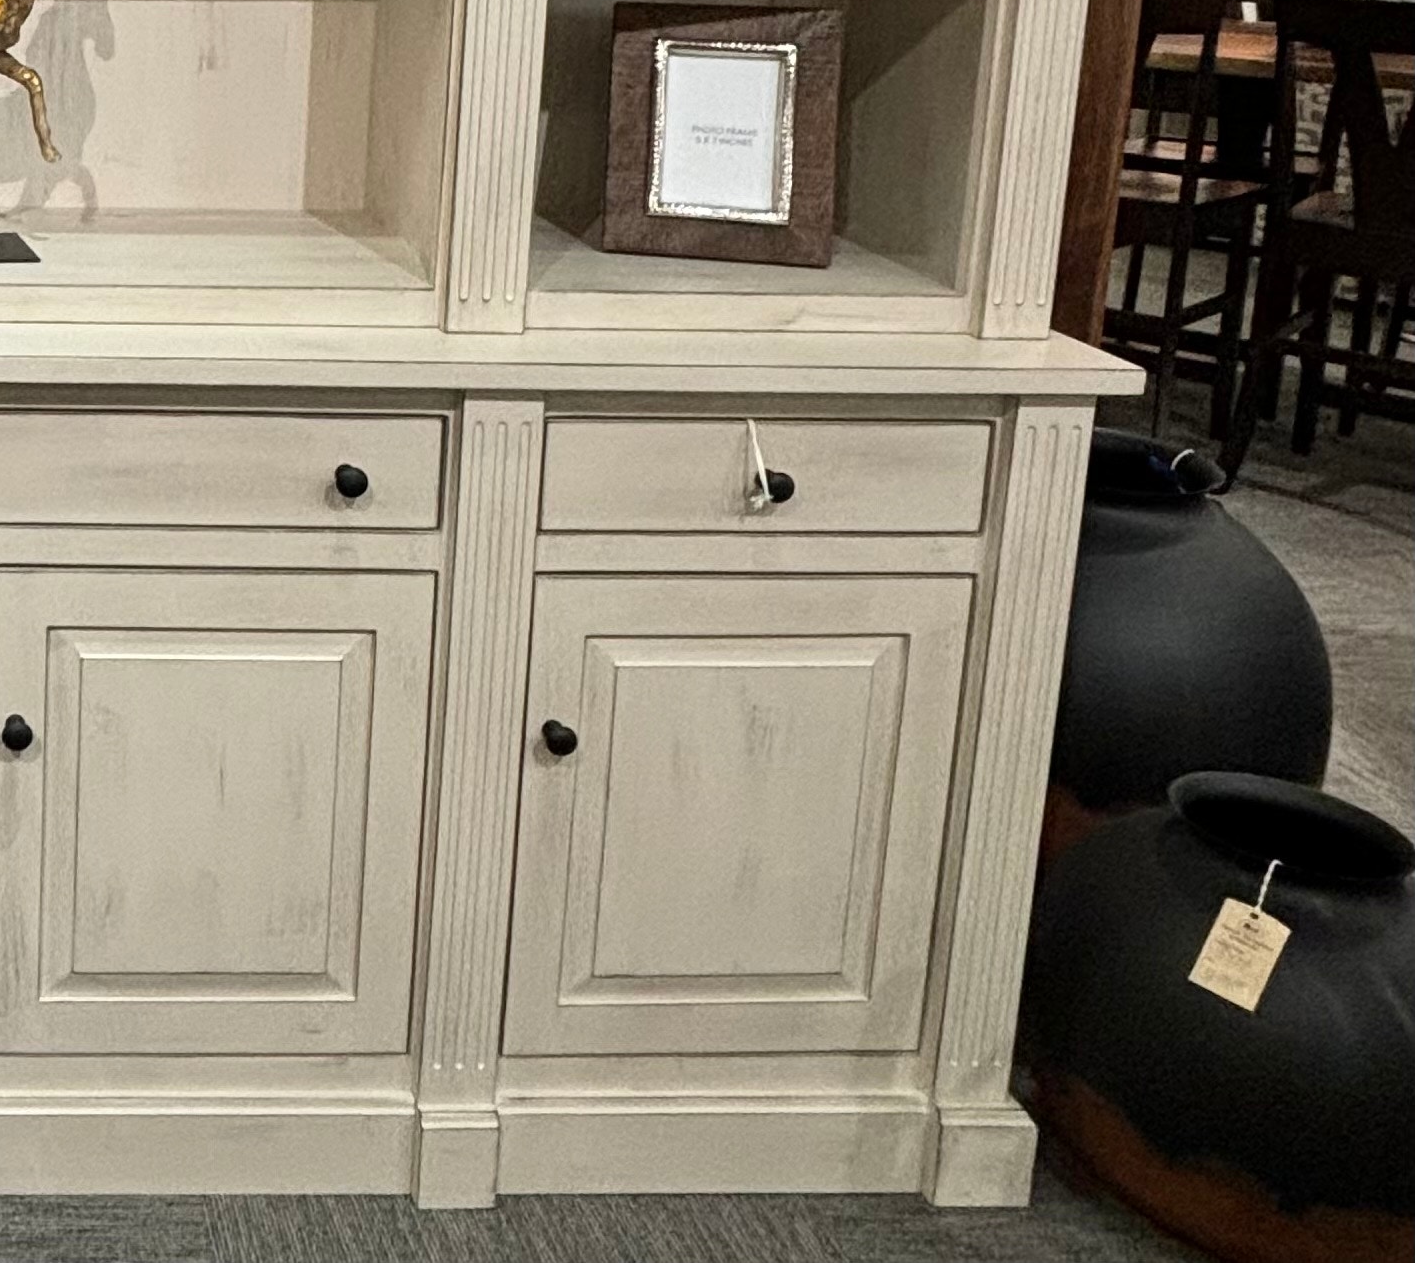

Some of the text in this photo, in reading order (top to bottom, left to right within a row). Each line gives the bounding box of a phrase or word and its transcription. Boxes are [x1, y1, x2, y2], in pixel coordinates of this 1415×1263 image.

[692, 124, 758, 137] PHOTO FRAME
[719, 137, 753, 147] INCHES
